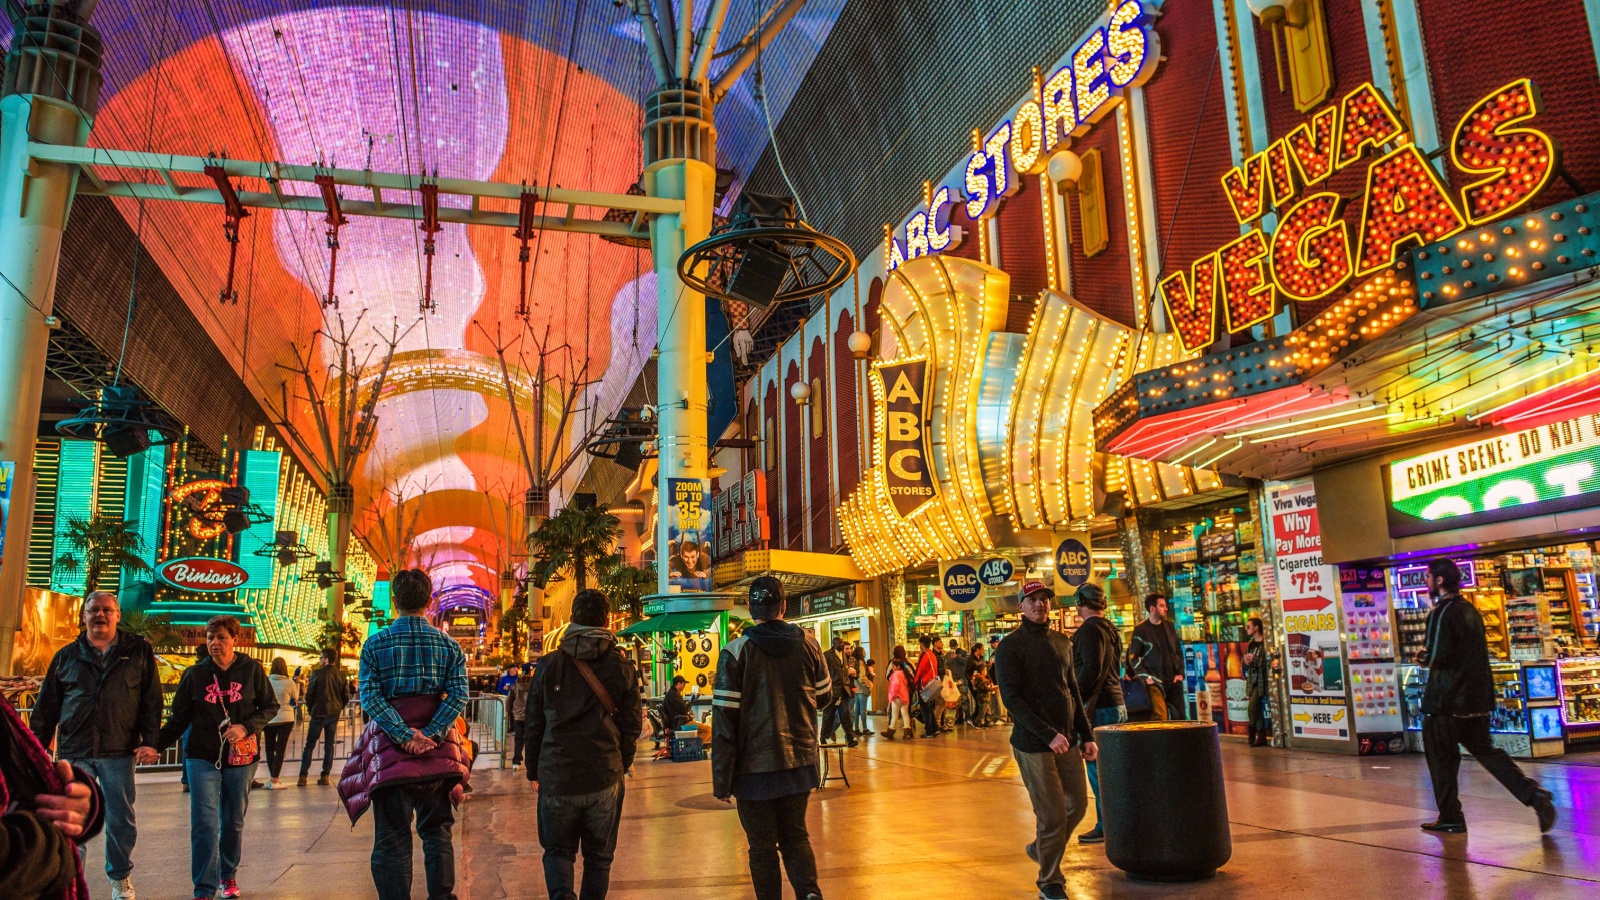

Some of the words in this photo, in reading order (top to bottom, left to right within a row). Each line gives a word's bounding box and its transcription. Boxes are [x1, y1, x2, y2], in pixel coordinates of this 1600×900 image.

[885, 185, 952, 278] ABC
[964, 0, 1147, 220] STORES
[1221, 82, 1402, 224] VIVA
[1158, 78, 1554, 354] VEGAS
[886, 369, 921, 481] ABC
[1406, 454, 1451, 490] CRIME
[1457, 438, 1513, 476] SCENE:
[1518, 428, 1541, 459] DO
[1548, 416, 1585, 451] NOT
[675, 481, 702, 492] ZOOM
[890, 486, 932, 496] STORES
[675, 491, 689, 502] UP
[691, 491, 702, 502] TO
[678, 501, 700, 520] 35
[1274, 499, 1293, 512] Viva
[679, 519, 700, 530] MPH
[1282, 511, 1312, 534] Why
[1276, 538, 1293, 554] Pay
[1295, 534, 1322, 550] More
[1059, 551, 1088, 566] ABC
[169, 563, 242, 585] Binion's
[983, 559, 1009, 578] ABC
[1062, 568, 1087, 576] STORES
[946, 573, 977, 587] ABC
[988, 576, 1004, 585] STORES
[950, 587, 976, 596] STORES
[1285, 613, 1337, 633] CIGARS
[1313, 713, 1332, 724] HERE
[1501, 737, 1528, 752] IPES
